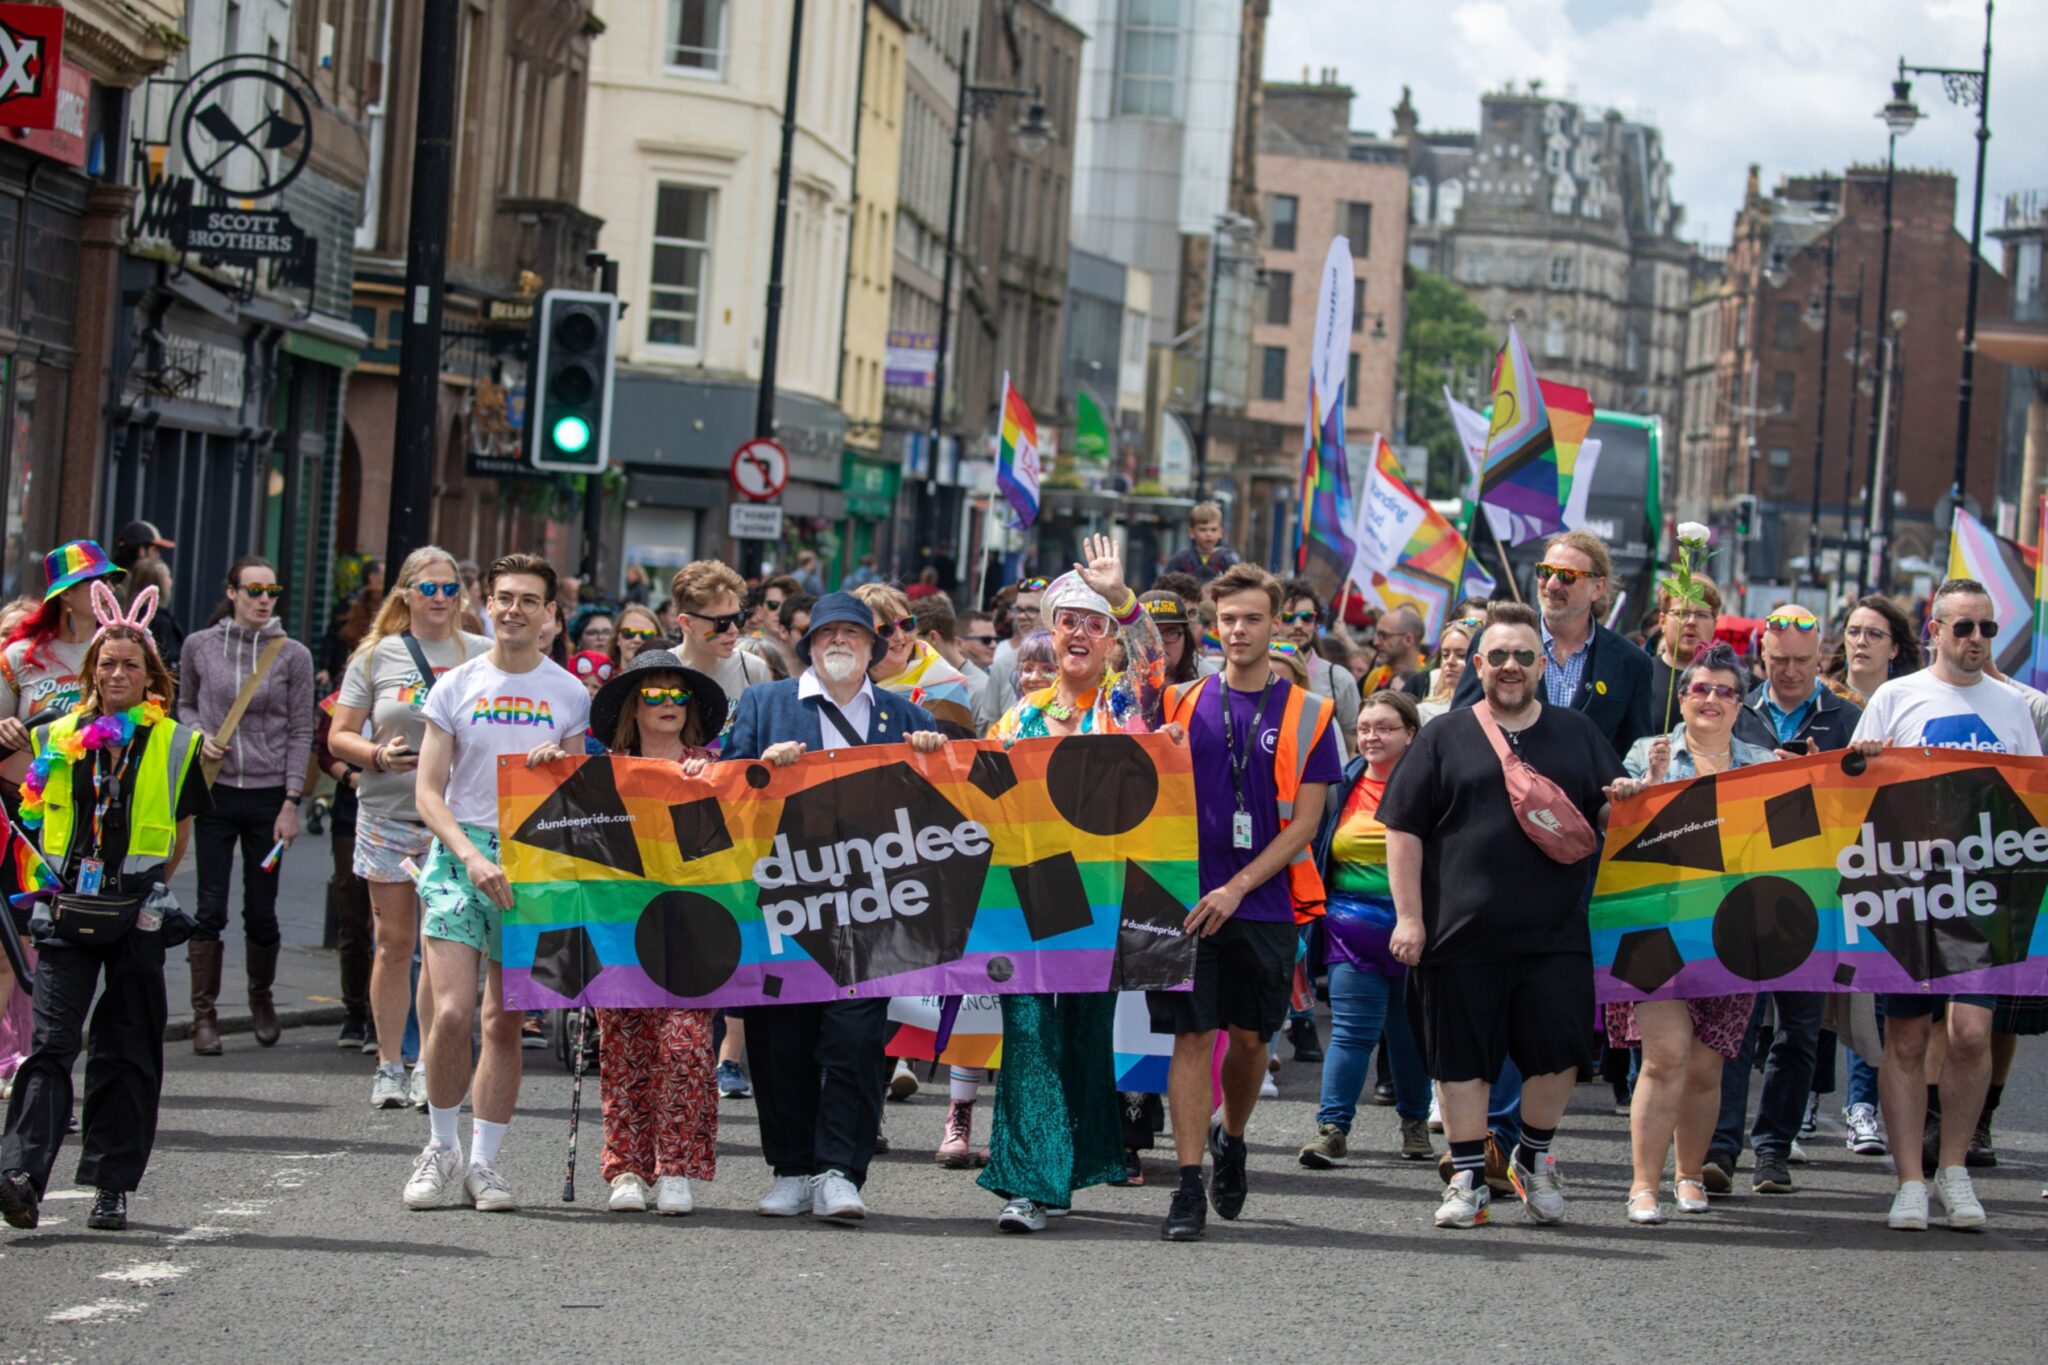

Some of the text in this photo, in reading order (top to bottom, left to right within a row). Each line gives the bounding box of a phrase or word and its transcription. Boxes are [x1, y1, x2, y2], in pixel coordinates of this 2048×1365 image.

[208, 212, 279, 233] SCOTT
[187, 229, 292, 252] BROTHERS
[1371, 478, 1409, 524] tanding
[470, 696, 555, 729] ABBA
[1919, 732, 2007, 754] ndee
[537, 813, 636, 831] dundeepride.com
[1537, 808, 1562, 829] NIKE
[1637, 817, 1725, 849] dundeepride.com
[753, 807, 991, 889] dundee
[1836, 811, 2048, 880] dundee
[762, 863, 930, 955] pride
[1841, 863, 1998, 945] pride
[1122, 918, 1181, 938] #dundeepride
